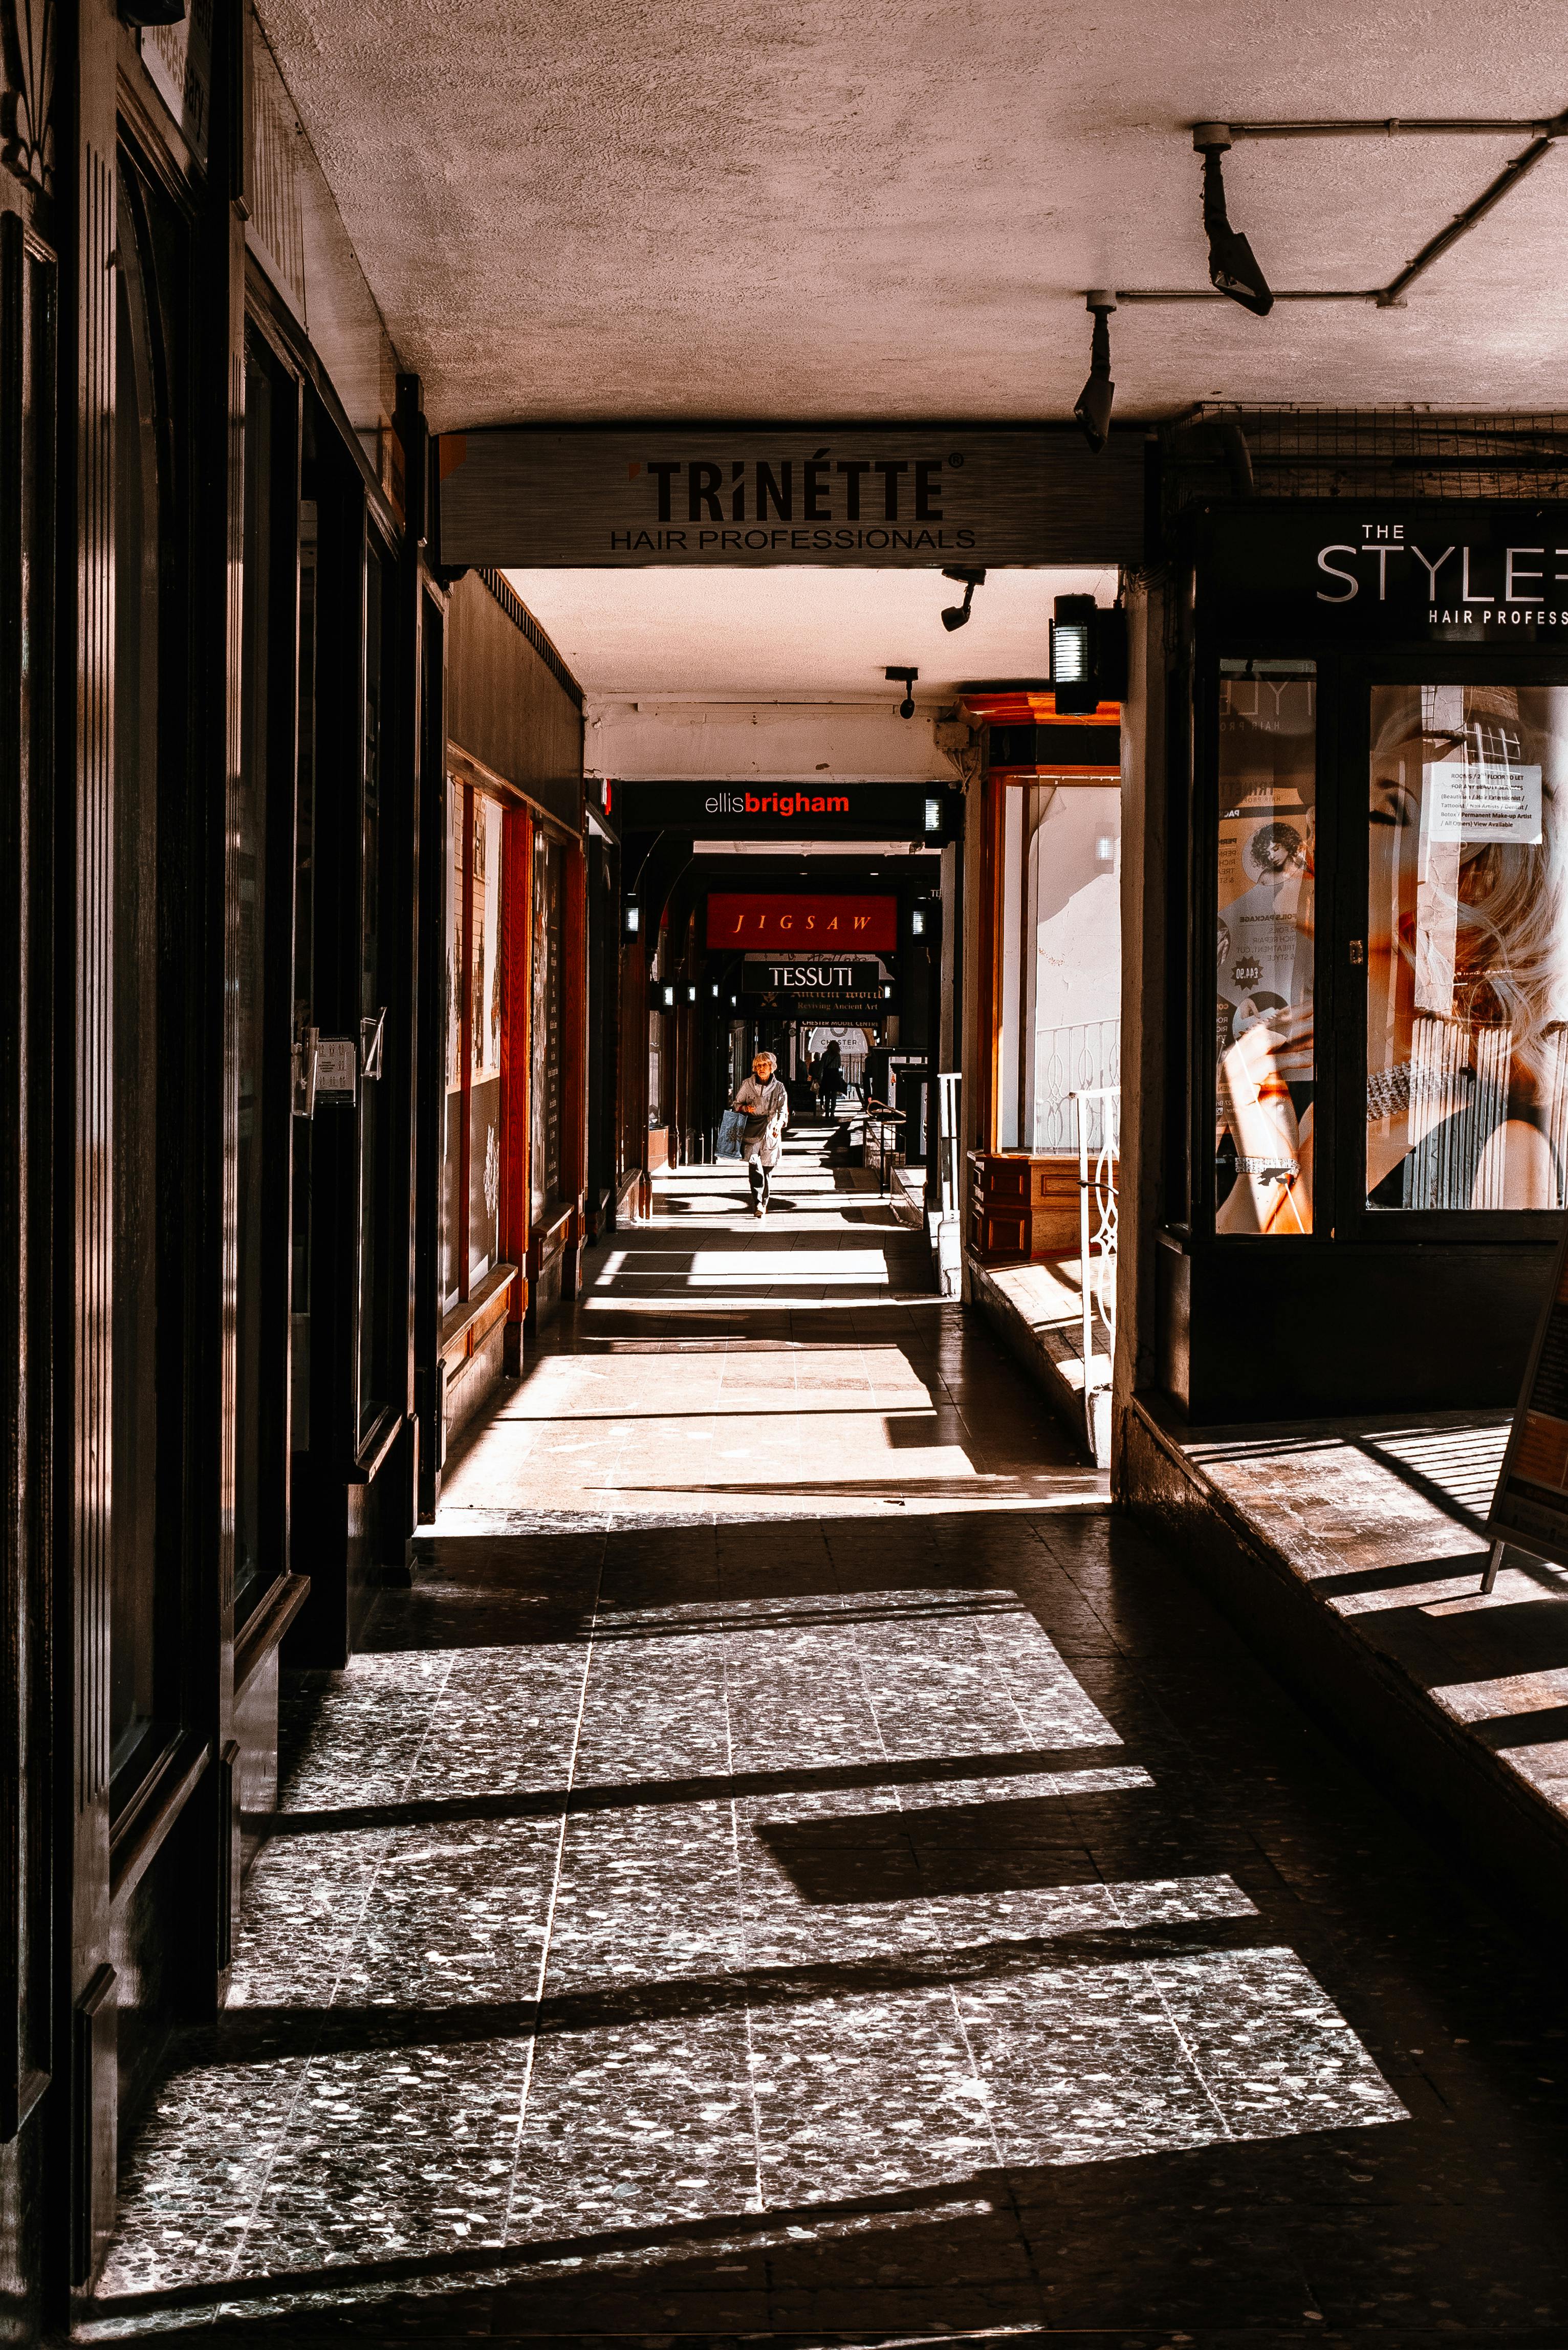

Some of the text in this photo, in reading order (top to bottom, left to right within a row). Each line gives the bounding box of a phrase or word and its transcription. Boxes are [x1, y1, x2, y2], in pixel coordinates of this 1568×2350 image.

[611, 529, 975, 551] HAIR PROFESSIONALS
[1362, 525, 1404, 539] THE
[1429, 610, 1568, 625] HAIR PROFESS
[705, 792, 850, 816] ellisbrigham
[732, 915, 871, 932] JIGSAW
[769, 967, 852, 986] TESSUTI
[798, 1002, 831, 1010] Reviving
